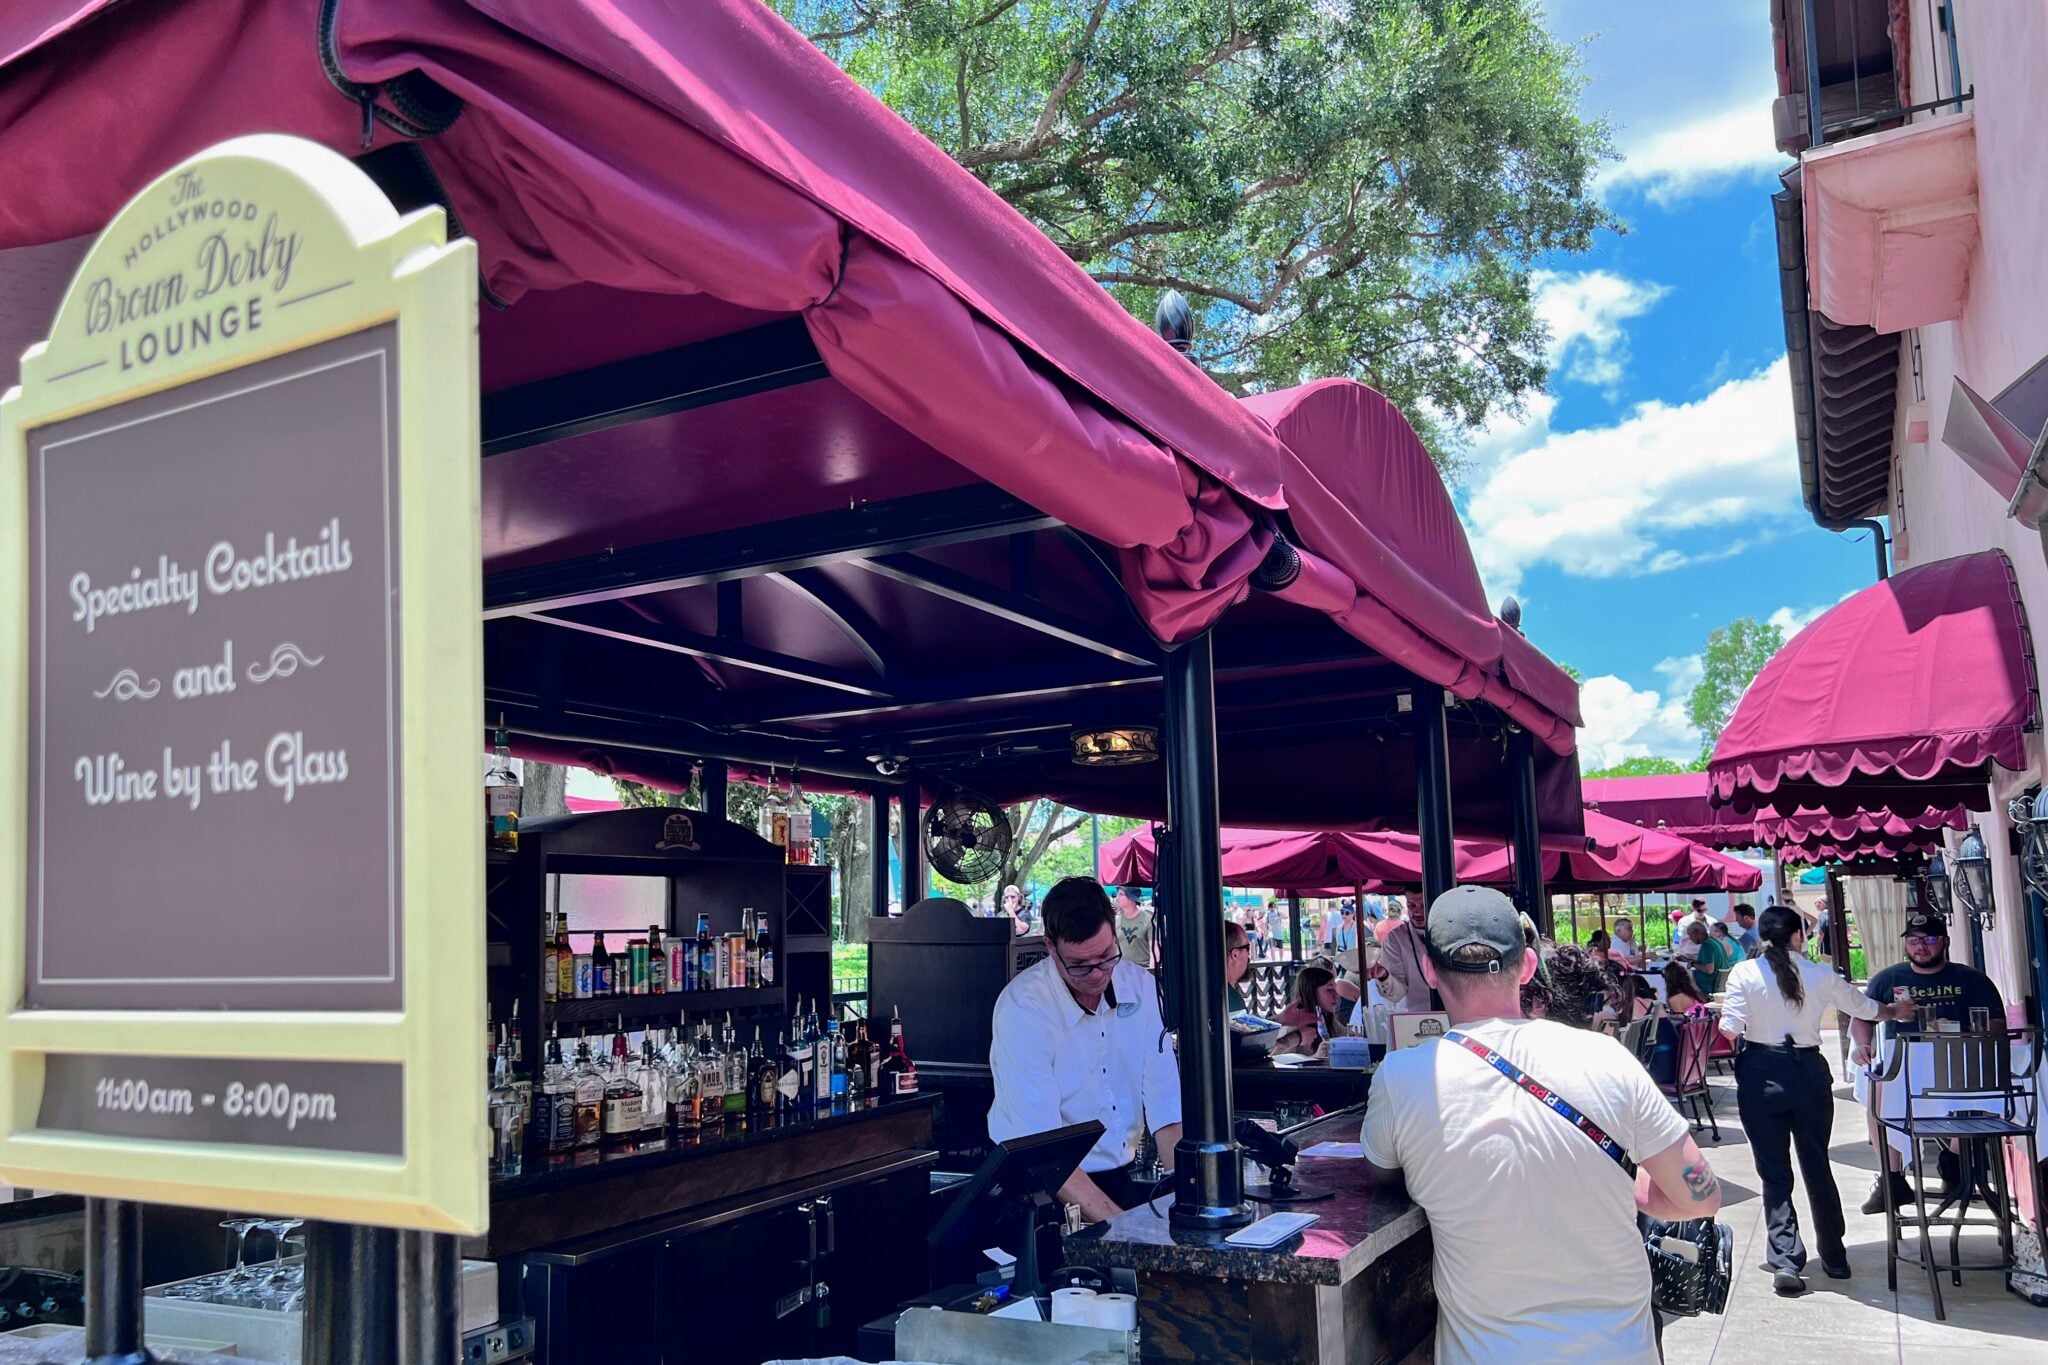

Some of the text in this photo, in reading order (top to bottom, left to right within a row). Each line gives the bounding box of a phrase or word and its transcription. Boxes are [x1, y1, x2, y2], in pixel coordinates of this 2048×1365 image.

[170, 170, 204, 205] The
[123, 200, 258, 268] HOLLYWOOD
[86, 212, 304, 336] Brown Derby
[122, 298, 262, 371] LOUNGE
[70, 517, 353, 634] Specialty Cocktails
[173, 640, 236, 699] and
[74, 731, 349, 811] Wine by the Glass
[703, 1072, 720, 1083] KNOB
[1472, 1045, 1512, 1074] adidas
[96, 1077, 194, 1115] 11:00am
[223, 1081, 337, 1131] 8:00pm
[1529, 1084, 1571, 1117] adidas
